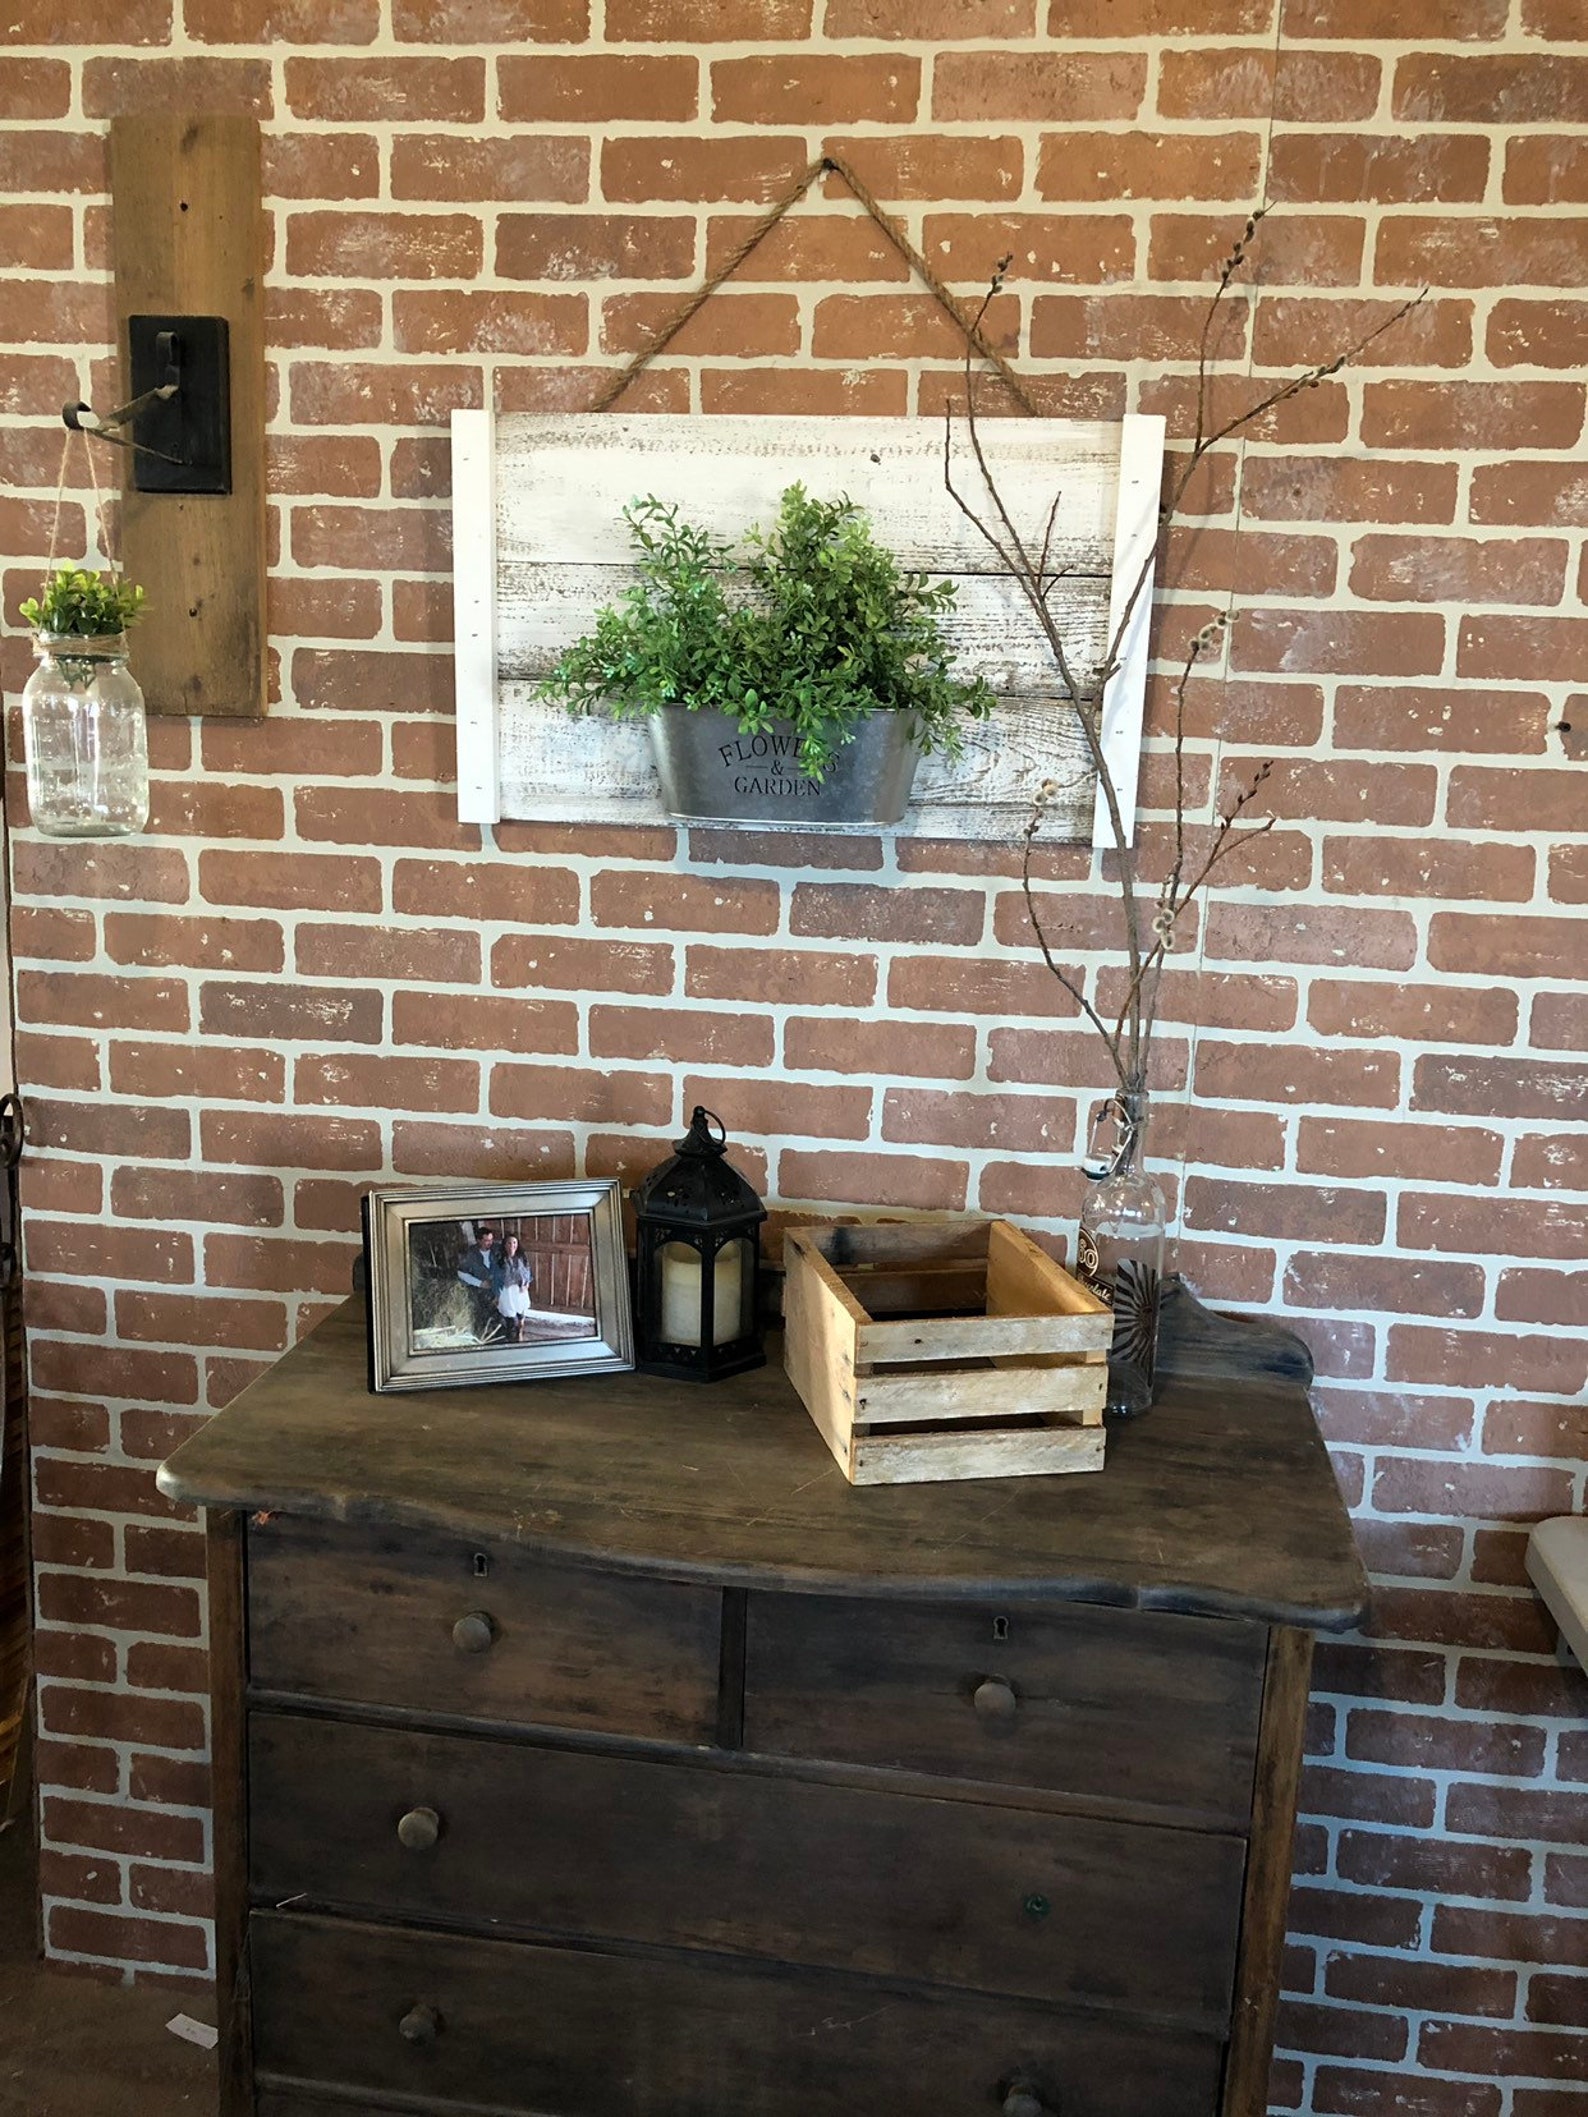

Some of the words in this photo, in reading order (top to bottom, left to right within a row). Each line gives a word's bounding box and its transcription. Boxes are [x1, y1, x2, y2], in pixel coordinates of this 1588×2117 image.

[718, 735, 840, 773] FLOWES
[770, 759, 784, 776] &
[734, 776, 820, 797] GARDEN
